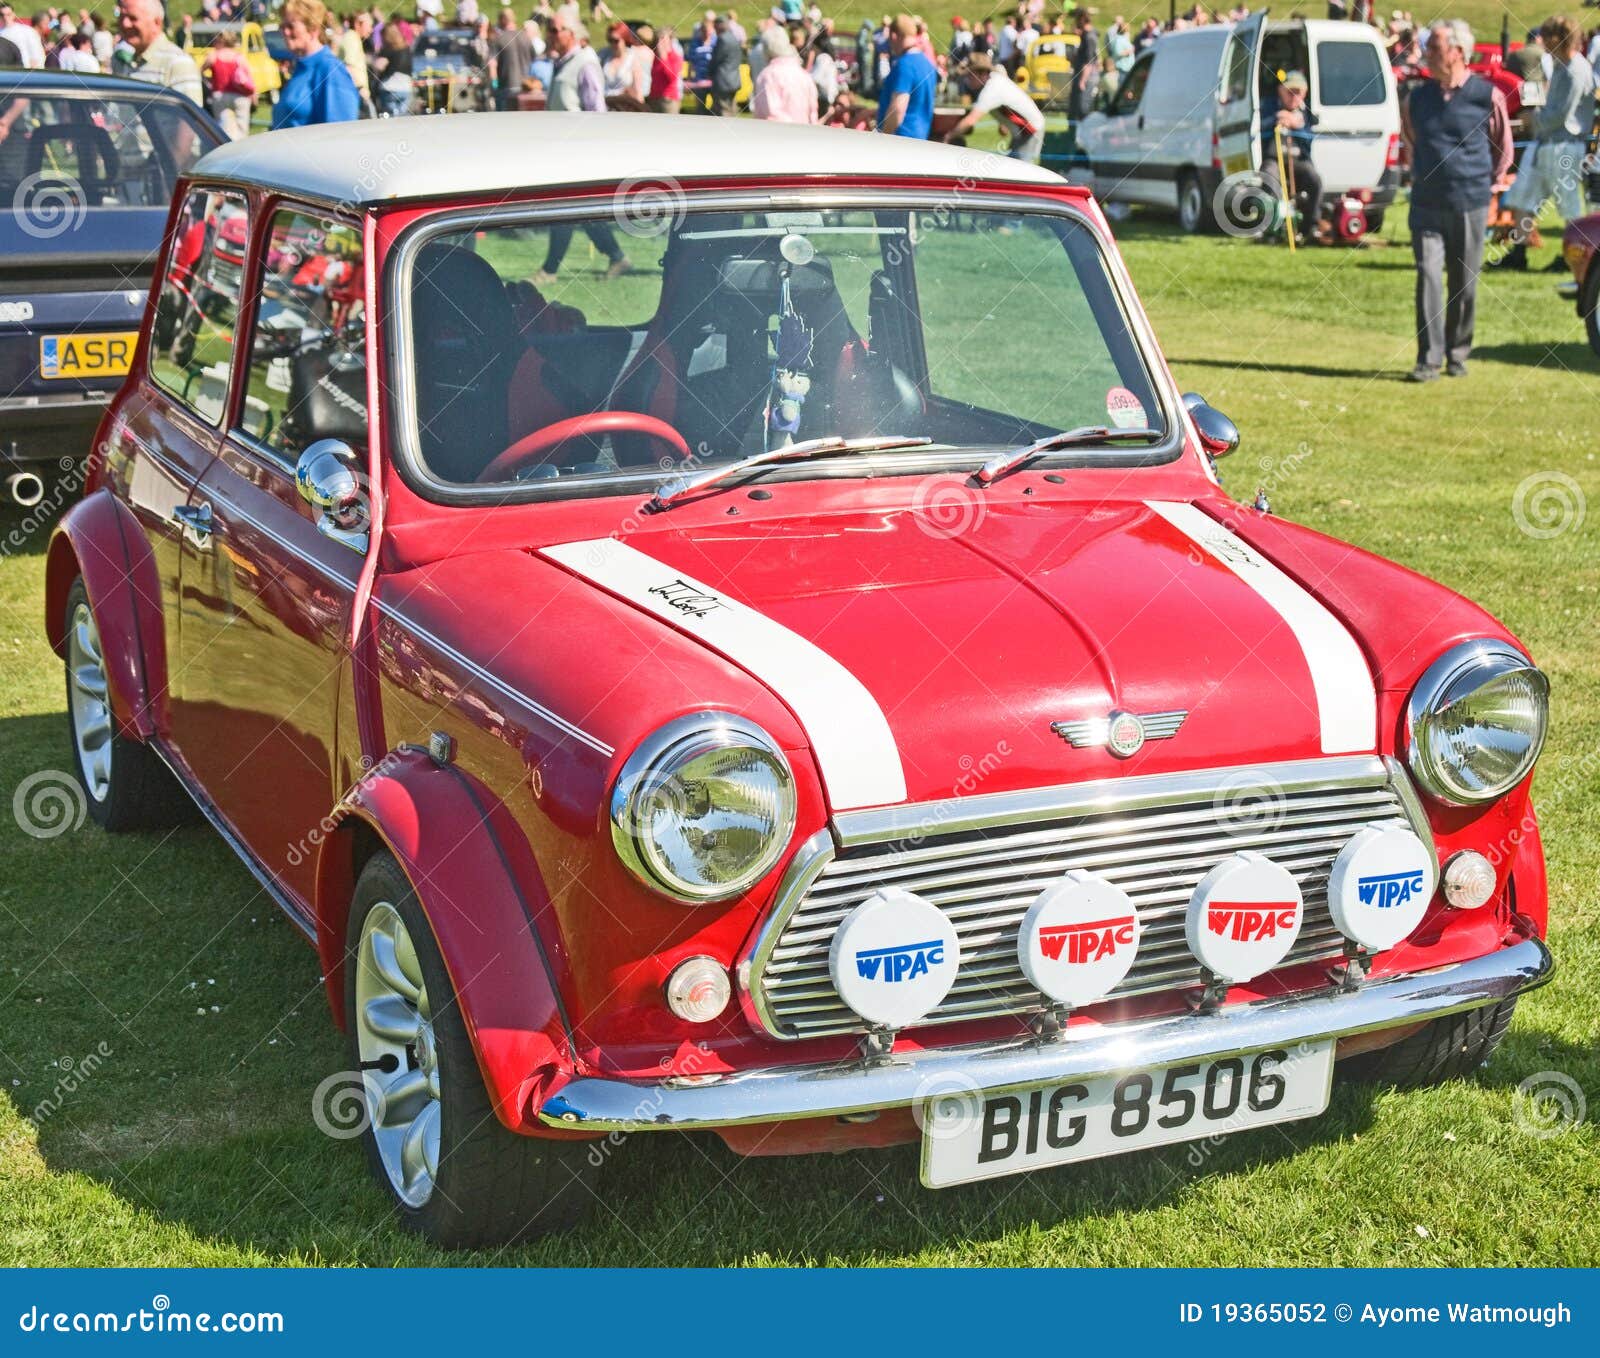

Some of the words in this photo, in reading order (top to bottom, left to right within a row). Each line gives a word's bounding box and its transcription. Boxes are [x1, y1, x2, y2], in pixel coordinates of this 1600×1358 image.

[61, 339, 129, 371] ASR
[1358, 869, 1424, 908] WIPAC
[1039, 915, 1135, 964] WIPAC
[1207, 901, 1298, 942] WIPAC
[855, 939, 945, 983] WIPAC
[977, 1083, 1091, 1164] BIG
[1110, 1049, 1289, 1138] 8506
